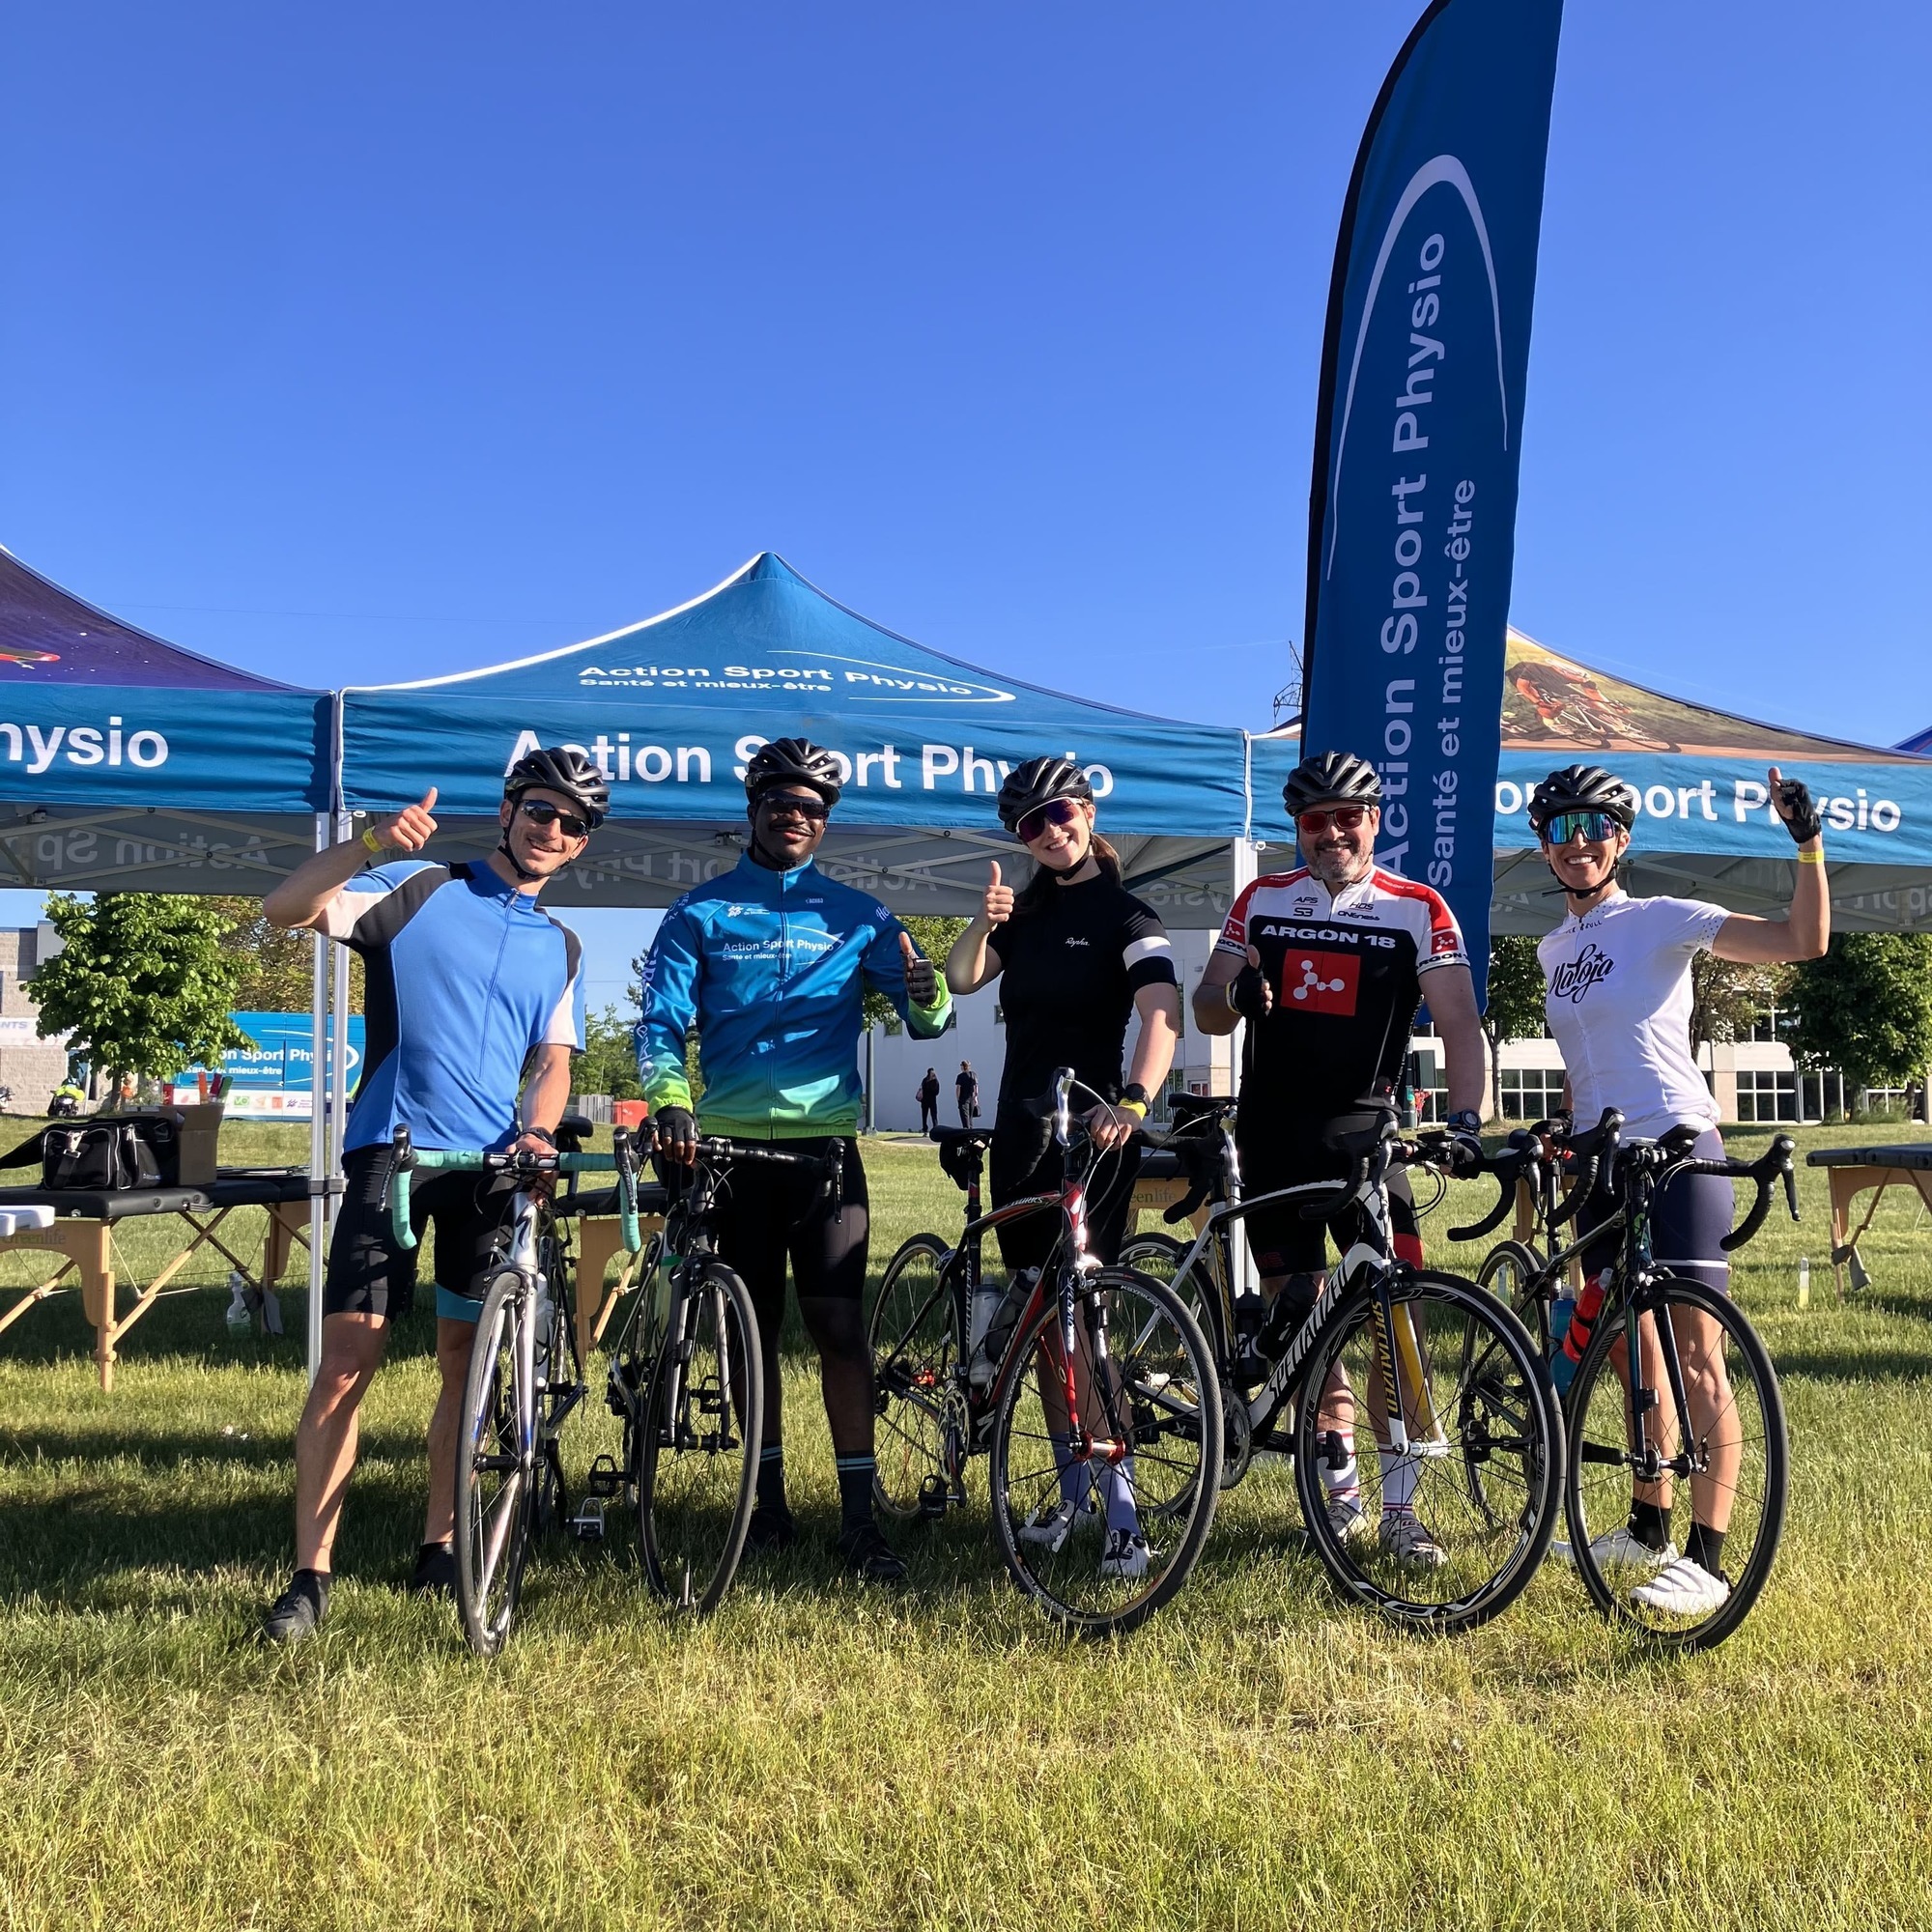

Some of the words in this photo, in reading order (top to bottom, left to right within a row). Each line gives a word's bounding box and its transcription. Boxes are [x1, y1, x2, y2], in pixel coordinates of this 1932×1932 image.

[1392, 233, 1446, 453] Physio
[1380, 473, 1428, 655] Sport
[1438, 479, 1476, 704] mieux-être
[579, 667, 710, 677] Action
[724, 666, 834, 681] Sport
[846, 671, 973, 696] Physio
[580, 678, 654, 688] Santé
[696, 680, 832, 692] mieux-être
[0, 716, 169, 774] hysio
[503, 729, 713, 782] Ation
[733, 734, 902, 789] Sort
[1437, 717, 1460, 757] et
[1374, 679, 1416, 880] Action
[1428, 770, 1459, 887] Santé
[723, 941, 760, 952] Action
[797, 939, 835, 952] Physio
[1260, 924, 1360, 944] ARGON
[1363, 934, 1396, 950] 18
[1548, 943, 1616, 1004] Maloja
[228, 1065, 283, 1075] mieux-être
[1128, 1189, 1176, 1203] eenlife
[1372, 1300, 1399, 1413] SPECIALIZED
